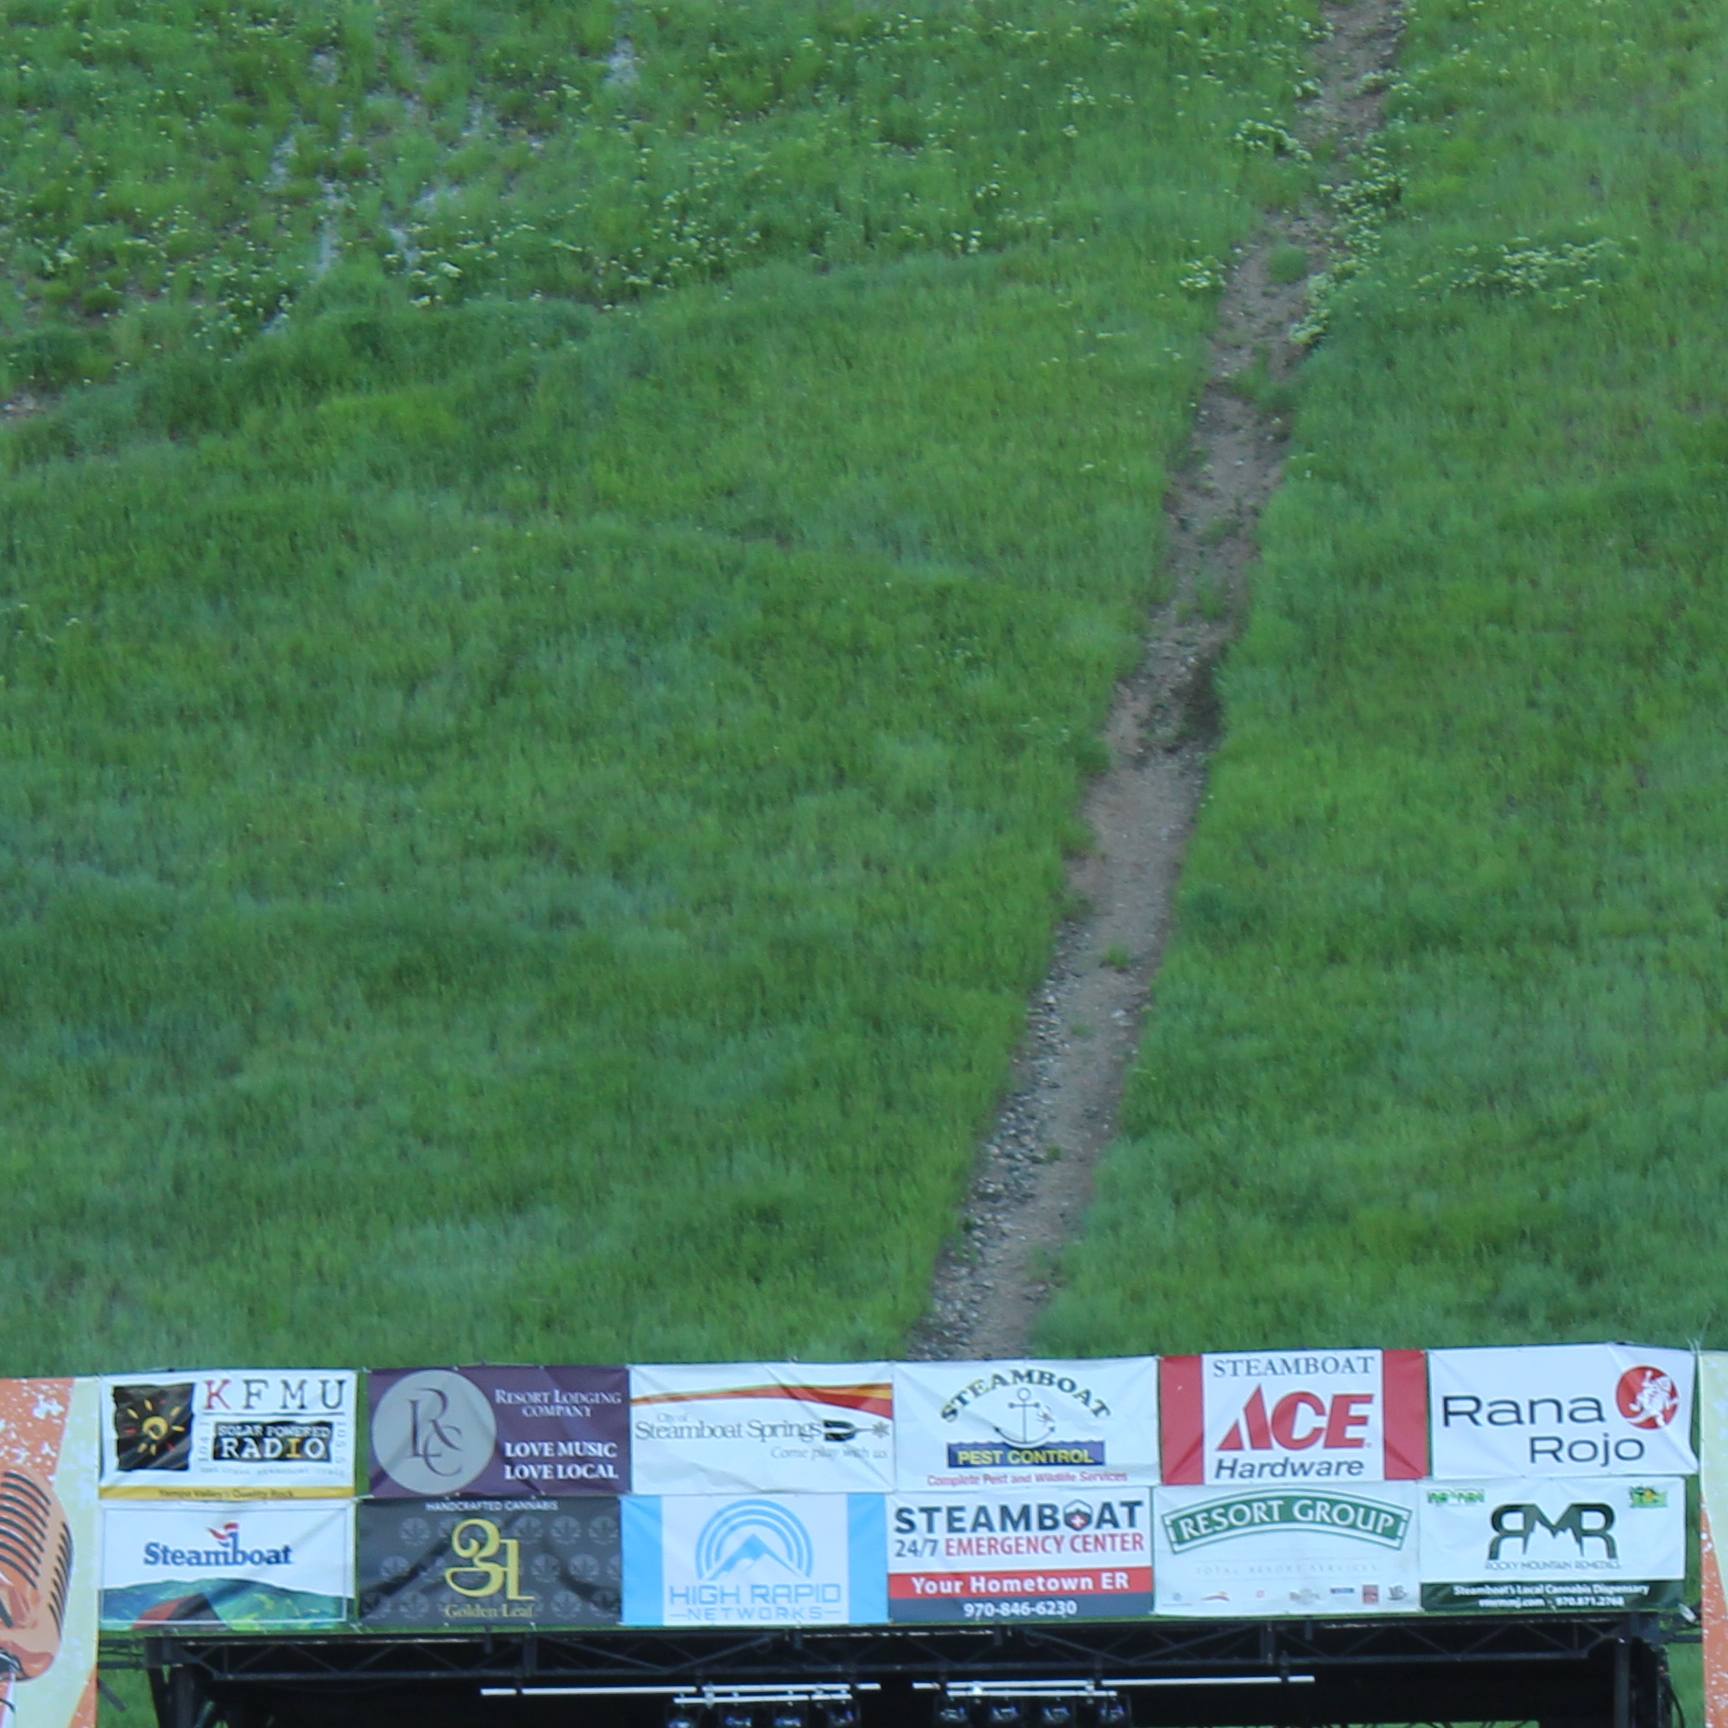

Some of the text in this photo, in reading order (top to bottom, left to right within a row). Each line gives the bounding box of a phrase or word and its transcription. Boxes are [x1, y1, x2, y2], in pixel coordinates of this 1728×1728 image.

[1213, 1356, 1374, 1377] STEAMBOAT
[204, 1379, 347, 1410] KFMU
[940, 1369, 1111, 1423] STEAMBOAT
[522, 1405, 593, 1418] COMPANY
[1216, 1383, 1375, 1451] ACE
[1442, 1395, 1607, 1427] Rana
[218, 1423, 332, 1438] SOLAR POWERED
[635, 1419, 822, 1442] Steamboat Springs
[221, 1438, 327, 1459] RADIO
[504, 1442, 618, 1458] LOVE MUSIC
[957, 1448, 1095, 1466] PEST CONTROL
[1529, 1432, 1645, 1467] Rojo
[504, 1464, 619, 1480] LOVE LOCAL
[1214, 1457, 1365, 1480] Hardware
[927, 1471, 1129, 1488] Complete Pest and Wildlife Services
[426, 1500, 559, 1512] HANDCRAFTED CANNABIS
[1178, 1499, 1395, 1541] RESORT GROUP
[144, 1530, 293, 1567] Steamboat
[894, 1532, 1145, 1558] 24/7 EMERGENCY CENTER
[669, 1583, 841, 1605] HIGH RAPID
[911, 1572, 1130, 1595] Your Hometown ER
[445, 1603, 535, 1618] Golden Leaf
[687, 1606, 823, 1621] NETWORKS
[963, 1600, 1077, 1618] 970-846-6230
